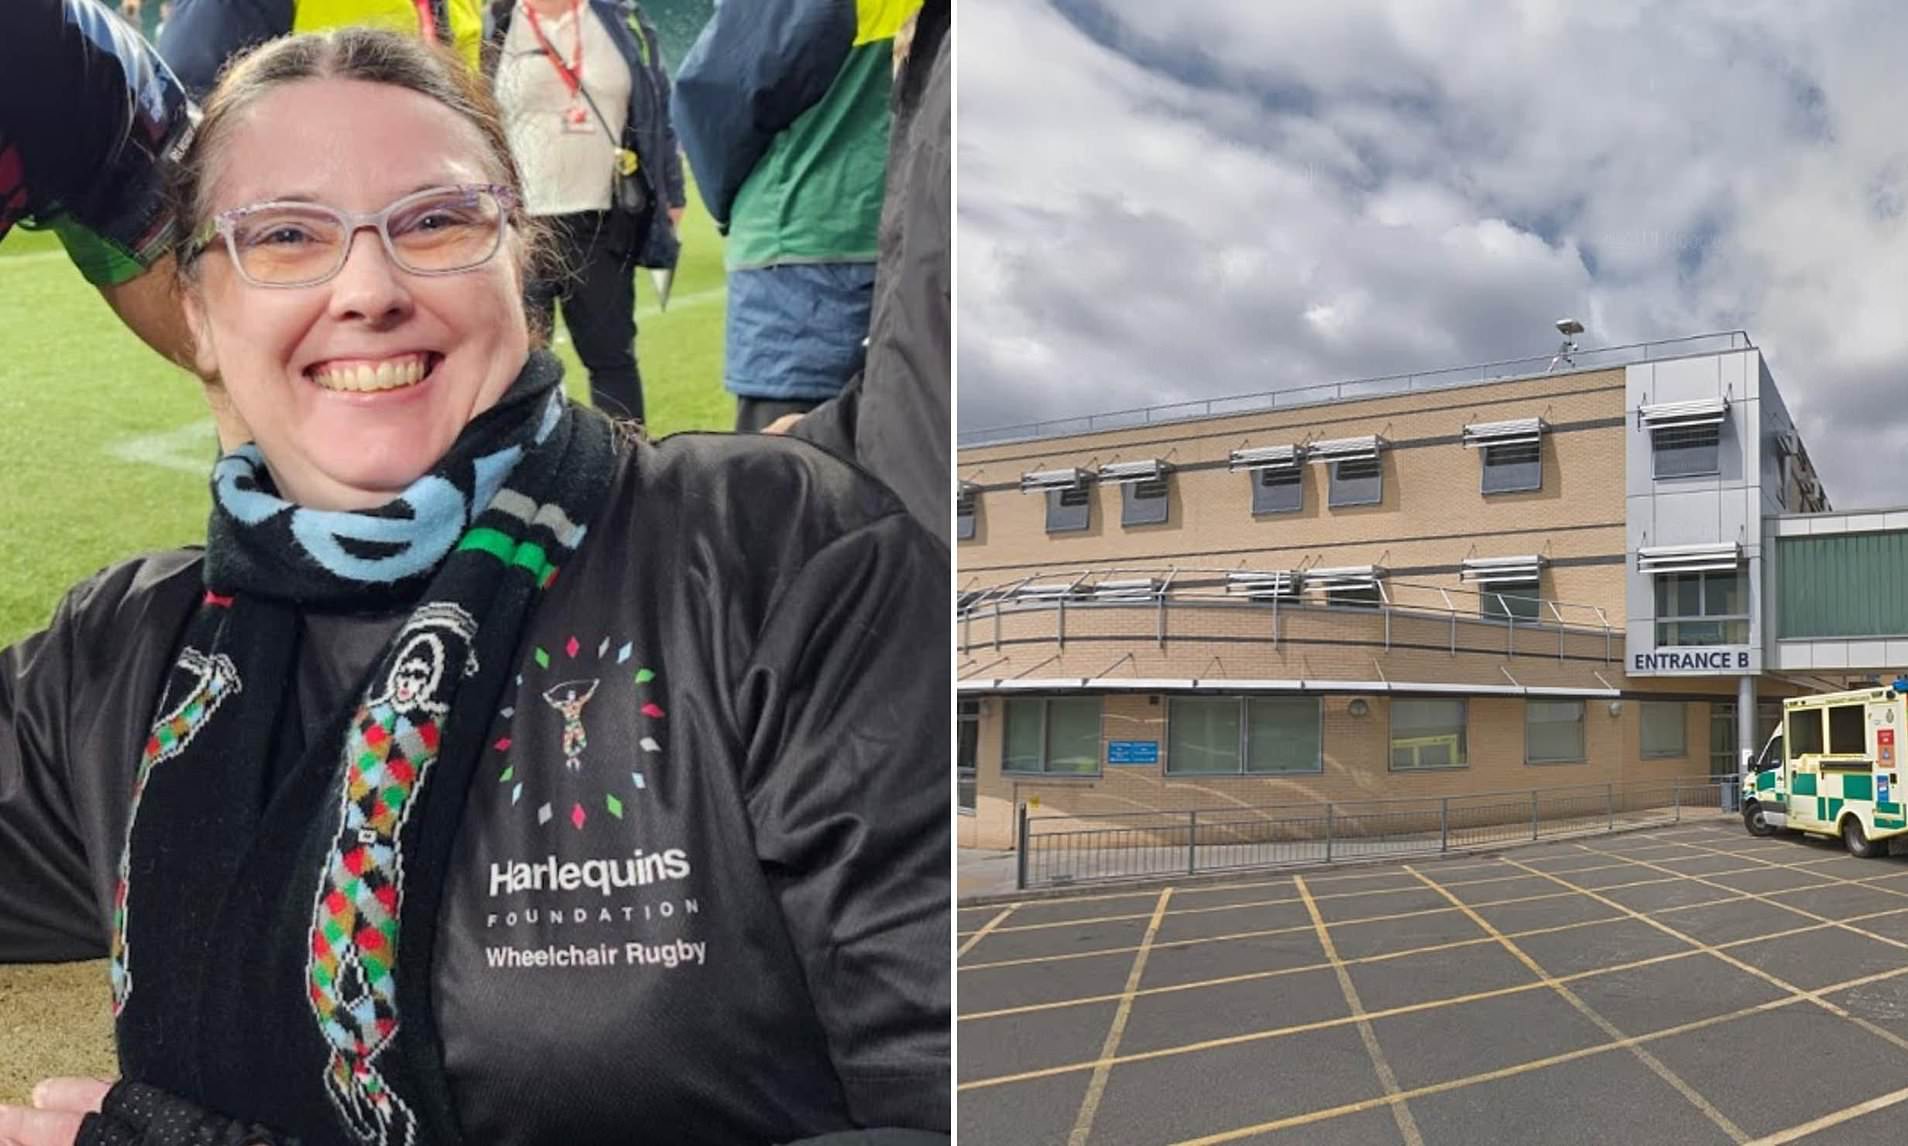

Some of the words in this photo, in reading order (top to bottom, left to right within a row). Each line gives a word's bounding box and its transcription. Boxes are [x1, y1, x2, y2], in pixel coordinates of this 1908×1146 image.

[1634, 652, 1731, 670] ENTRANCE
[1738, 652, 1749, 668] B
[489, 848, 691, 897] Harlequins
[487, 898, 699, 928] FOUNDATION
[486, 944, 619, 968] Wheelchair
[625, 938, 707, 969] Rugby
